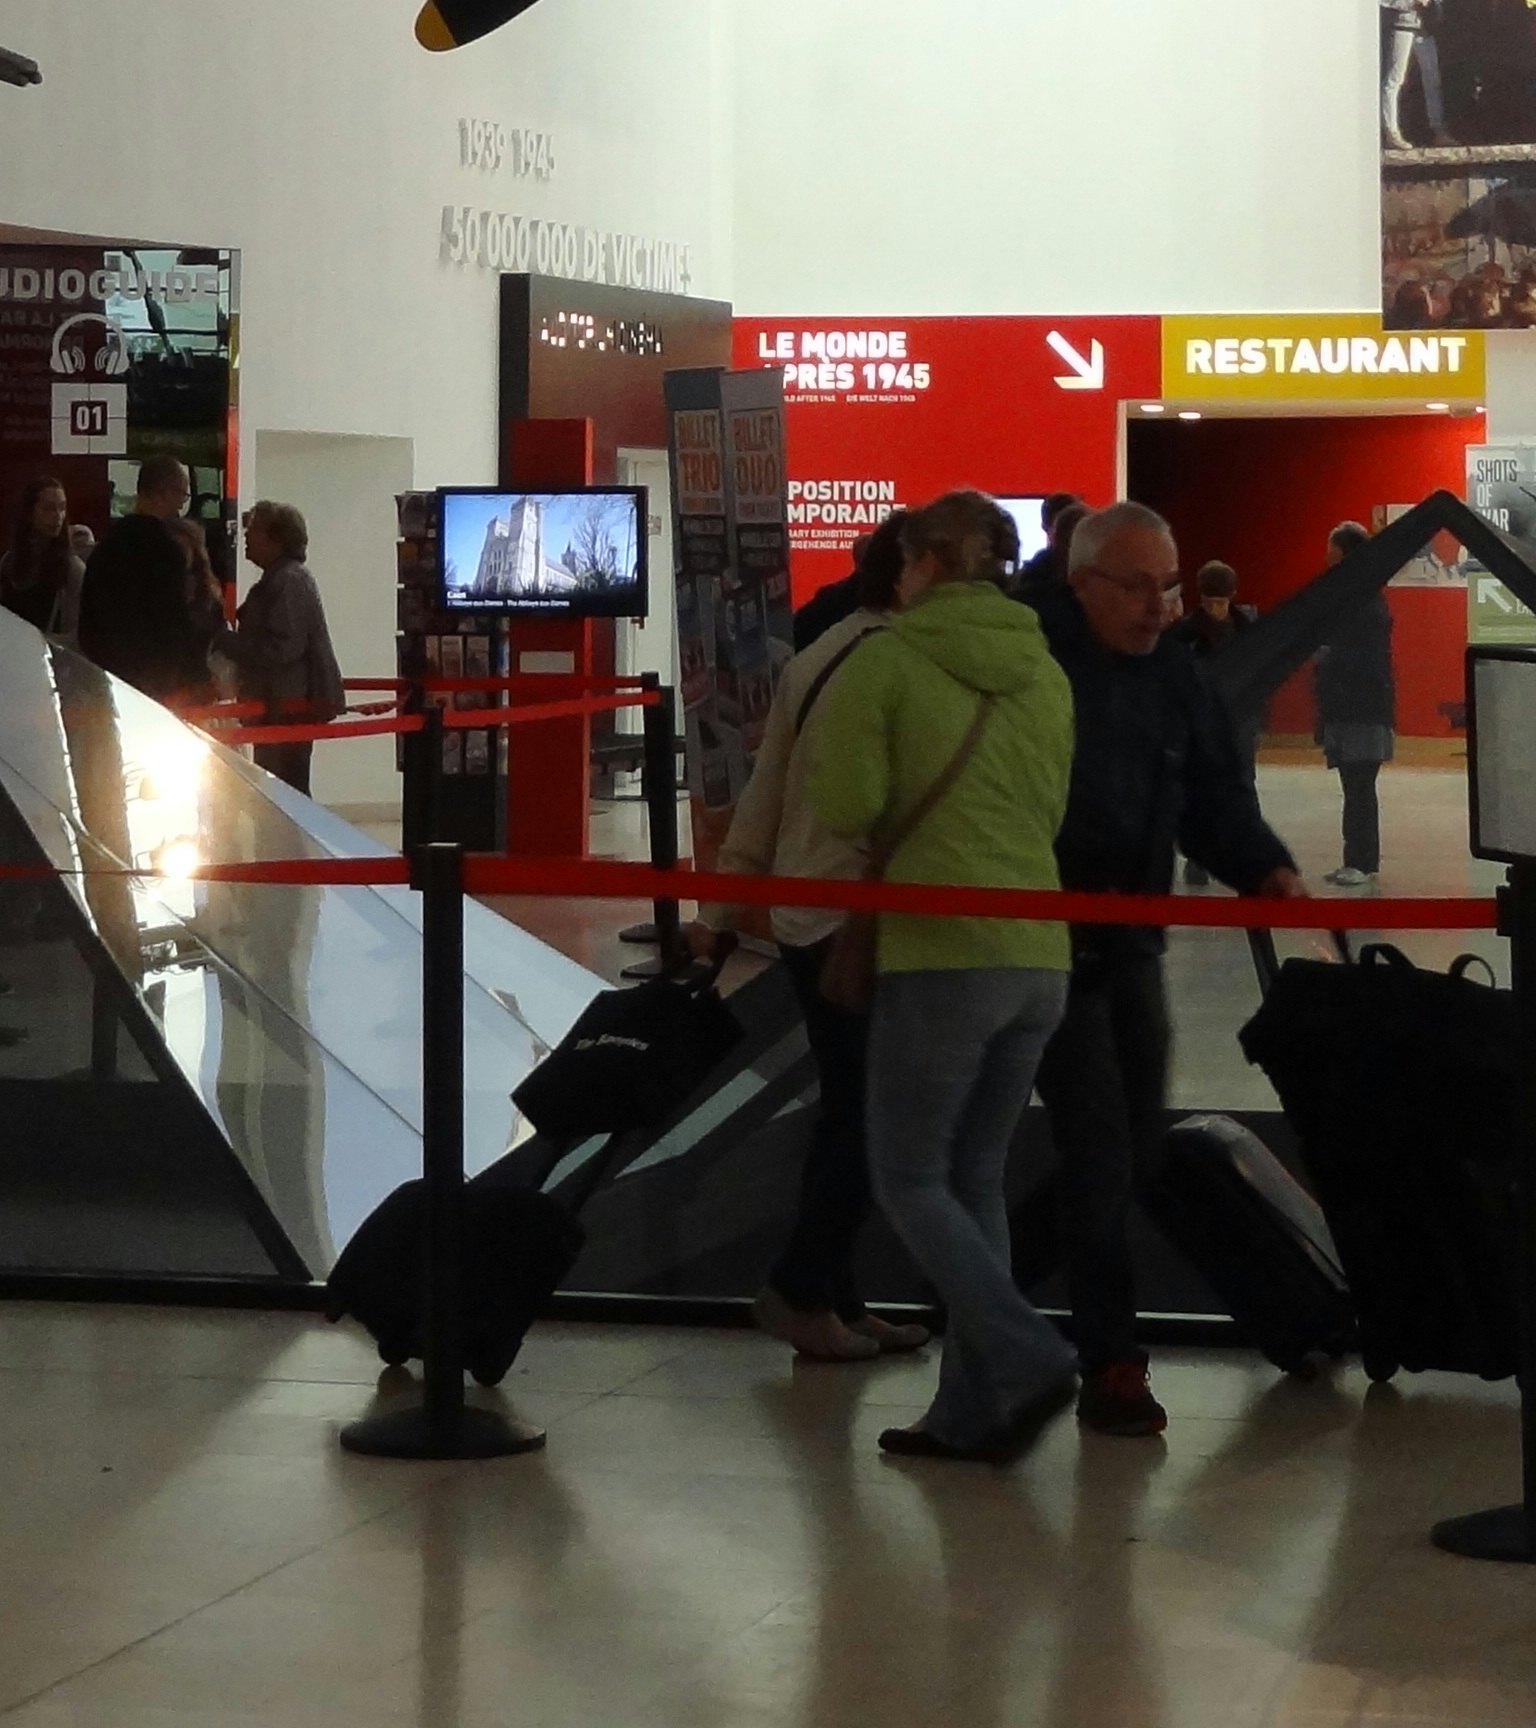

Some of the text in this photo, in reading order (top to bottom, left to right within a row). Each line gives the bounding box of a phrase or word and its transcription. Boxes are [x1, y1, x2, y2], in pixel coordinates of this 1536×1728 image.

[485, 211, 530, 271] 000
[536, 220, 578, 279] 000
[759, 331, 907, 359] LE MONDE
[1185, 337, 1466, 374] RESTAURANT
[764, 354, 930, 390] PRÈS 1945
[76, 406, 103, 431] 01
[1477, 459, 1517, 483] SHOTS
[788, 480, 895, 501] POSITION
[1476, 483, 1493, 507] OF
[787, 503, 907, 524] MPORAIR
